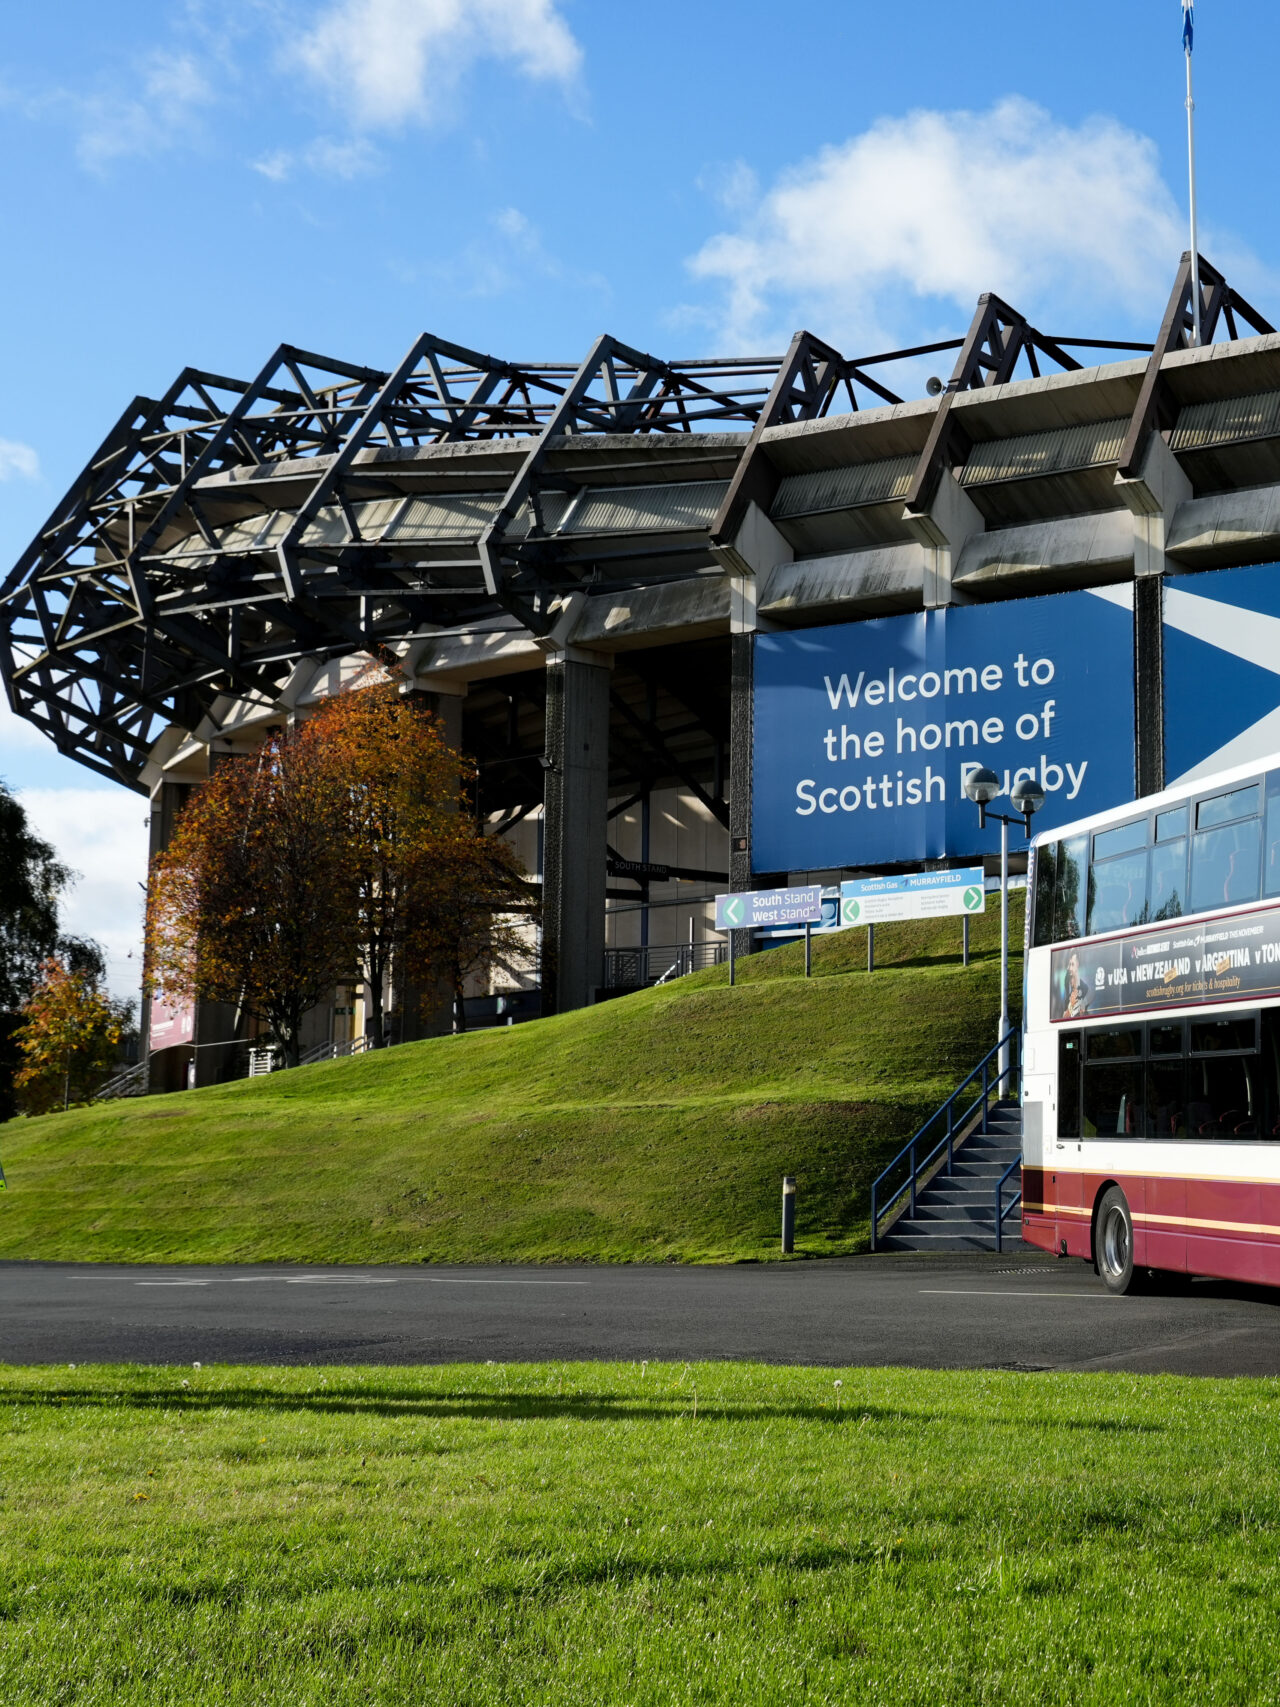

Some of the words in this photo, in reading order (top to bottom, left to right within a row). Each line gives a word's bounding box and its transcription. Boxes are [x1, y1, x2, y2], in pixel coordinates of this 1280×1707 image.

[823, 663, 1003, 710] Welcome
[1014, 653, 1055, 687] to
[823, 723, 884, 762] the
[896, 717, 1004, 753] home
[1015, 700, 1056, 741] of
[795, 766, 945, 816] Scottish
[615, 861, 641, 871] SOUTH
[642, 864, 667, 874] STAND
[861, 881, 886, 892] Scottish
[886, 881, 898, 890] Gas
[910, 874, 962, 887] MURRAYFIELD
[752, 894, 782, 908] South
[784, 891, 814, 905] Stand
[752, 910, 778, 922] West
[1108, 973, 1113, 986] v
[1113, 967, 1128, 985] USA
[1131, 970, 1136, 983] v
[1136, 963, 1154, 982] NEW
[1154, 957, 1191, 979] ZEALAND
[1195, 959, 1201, 973] v
[1255, 950, 1261, 965] v
[1184, 980, 1192, 992] for
[1208, 977, 1214, 990] &
[1214, 975, 1240, 991] hospitality
